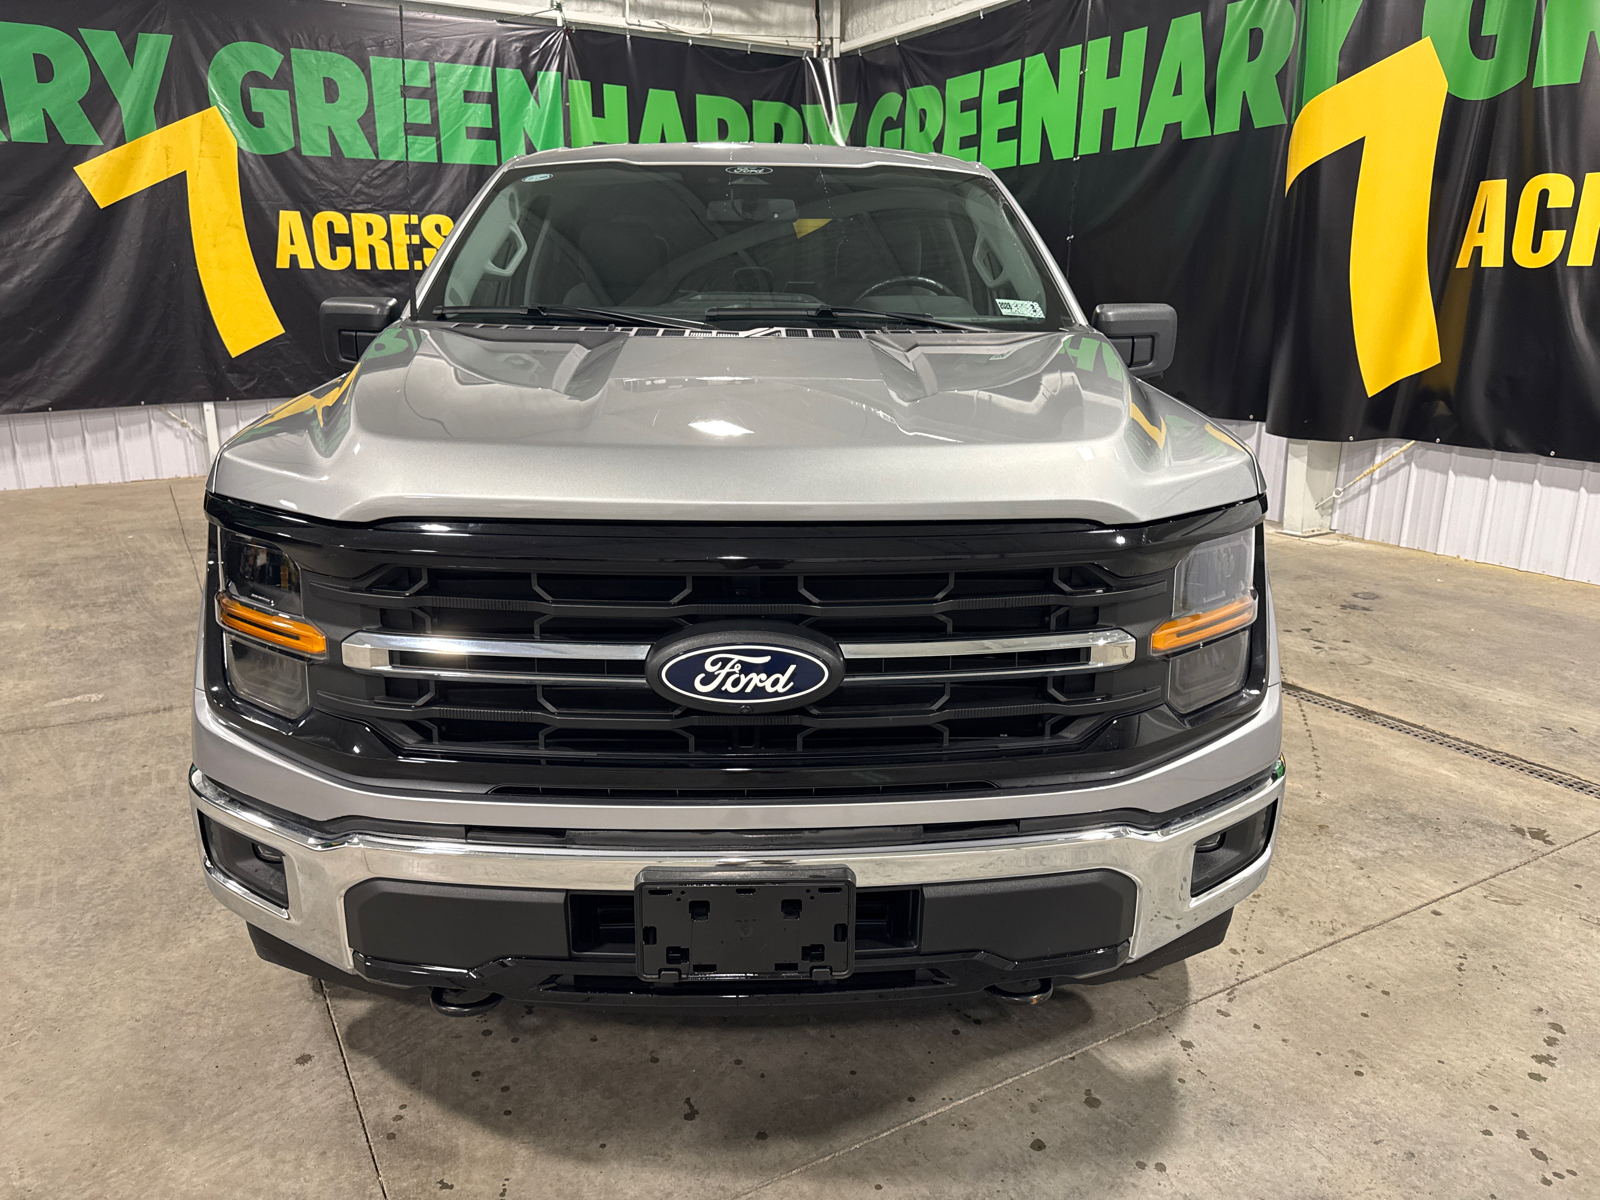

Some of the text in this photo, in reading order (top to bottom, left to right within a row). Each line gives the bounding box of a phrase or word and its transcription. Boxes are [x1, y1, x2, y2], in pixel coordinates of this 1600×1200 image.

[0, 21, 564, 166] RY GREEN
[866, 44, 1083, 170] GREEN
[1078, 0, 1363, 155] HARY
[73, 106, 455, 358] 7 ACRES
[1285, 36, 1441, 398] 7
[694, 653, 797, 693] Ford
